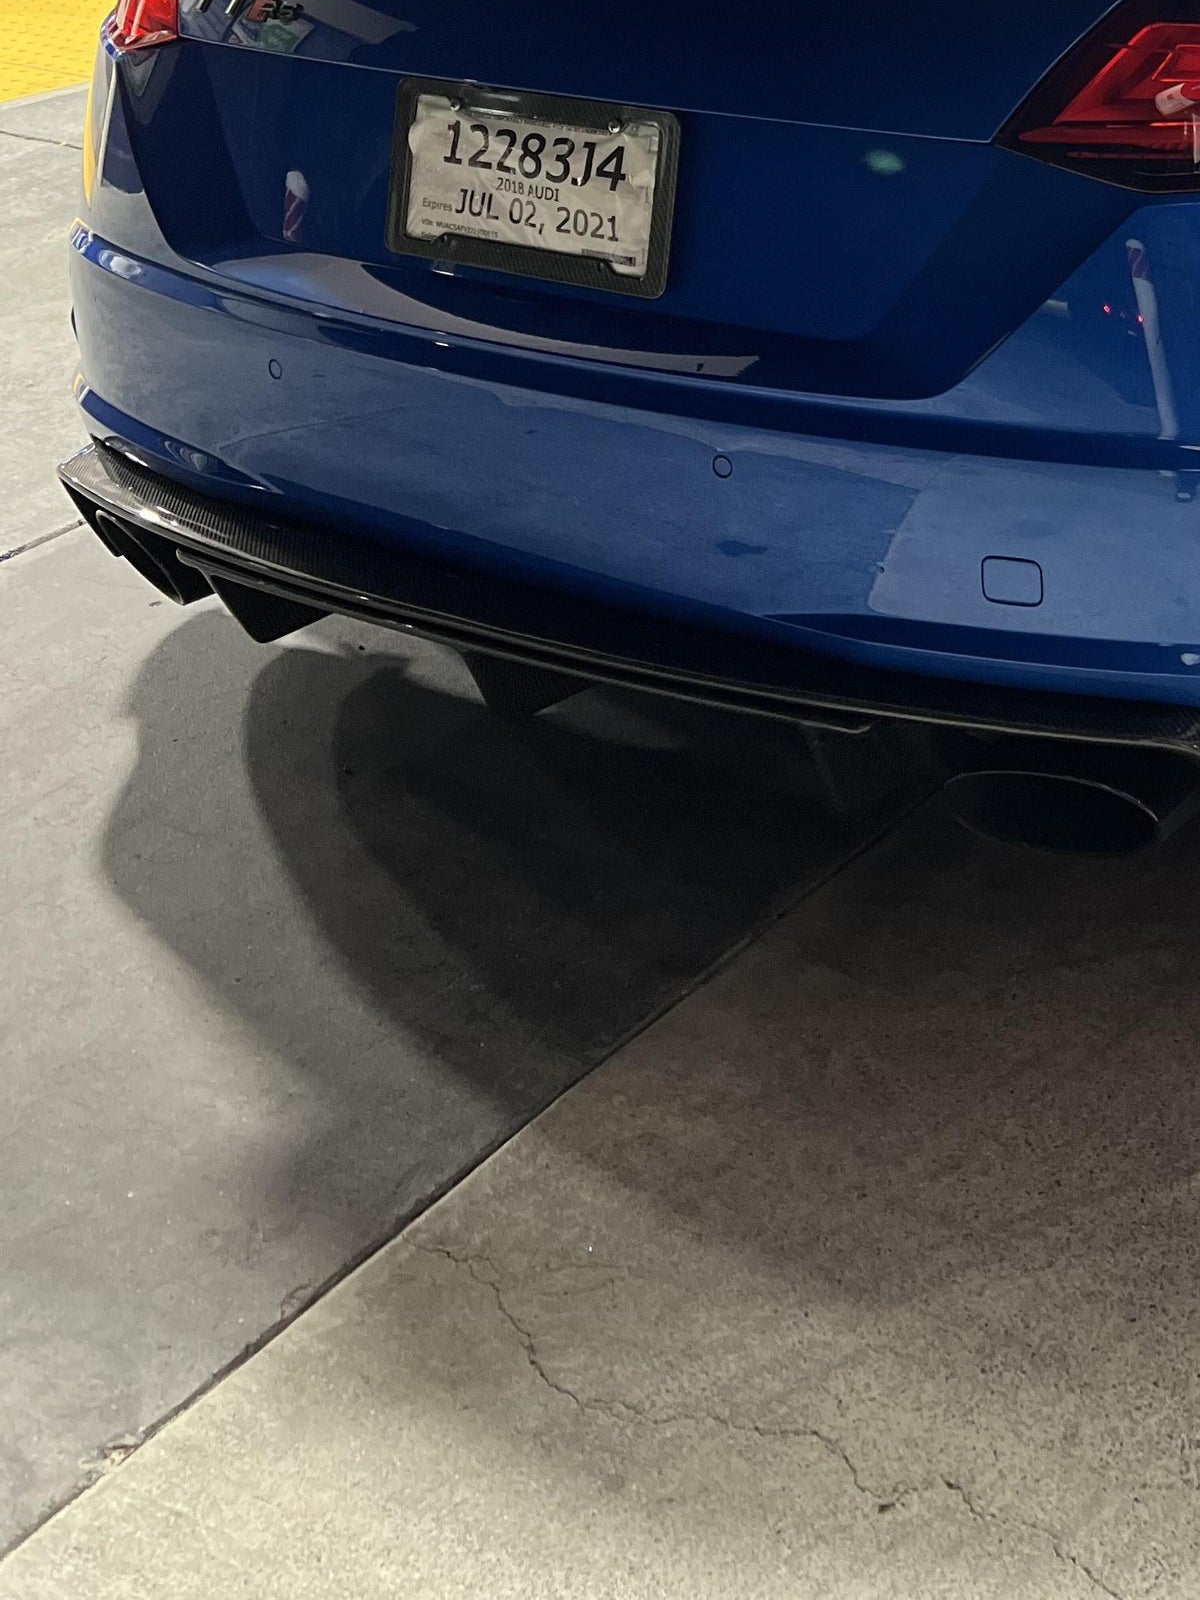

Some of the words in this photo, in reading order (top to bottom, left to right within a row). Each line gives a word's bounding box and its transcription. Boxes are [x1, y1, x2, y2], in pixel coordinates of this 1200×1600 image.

[443, 119, 627, 192] 12283J4
[422, 197, 453, 212] Expires
[455, 188, 499, 220] JUL
[555, 206, 620, 242] 2021
[495, 177, 525, 196] 2018
[527, 184, 560, 202] AUDI
